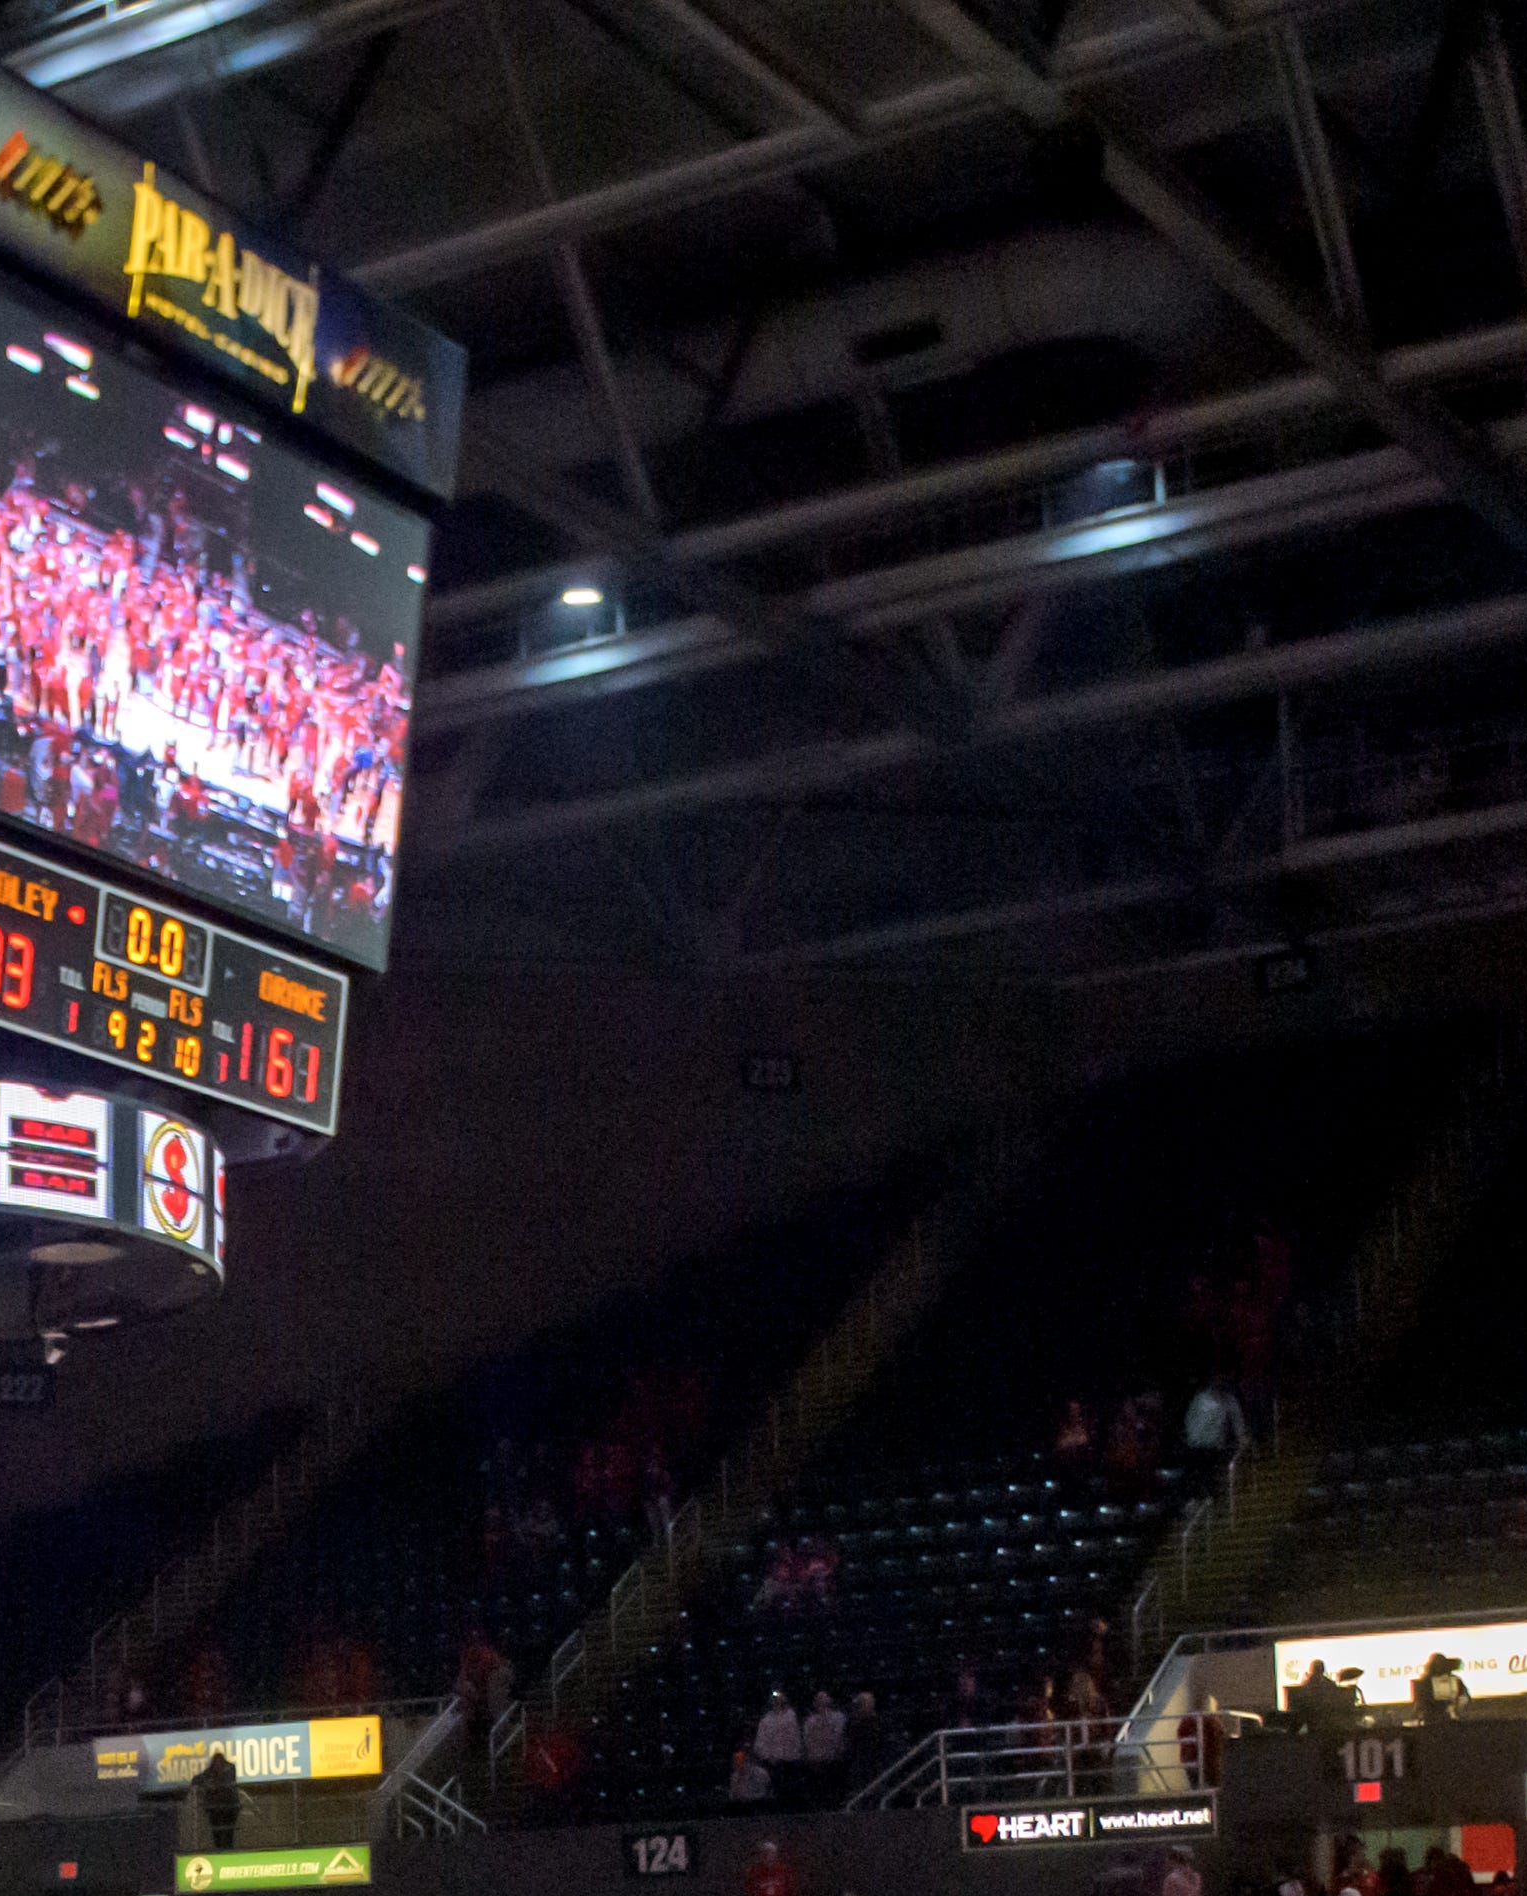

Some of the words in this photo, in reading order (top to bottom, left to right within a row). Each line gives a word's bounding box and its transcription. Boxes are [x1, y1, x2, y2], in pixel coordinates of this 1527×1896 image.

[126, 906, 185, 977] 0.0
[92, 960, 129, 1001] FLS
[169, 988, 204, 1028] FLS
[258, 970, 329, 1023] DRAKE
[108, 1009, 127, 1049] 9
[136, 1020, 157, 1062] 2
[174, 1035, 202, 1078] 10
[264, 1027, 321, 1104] 61
[1338, 1738, 1406, 1781] 101
[998, 1811, 1087, 1840] HEART
[1099, 1807, 1212, 1830] www.heart.net
[630, 1834, 690, 1875] 124
